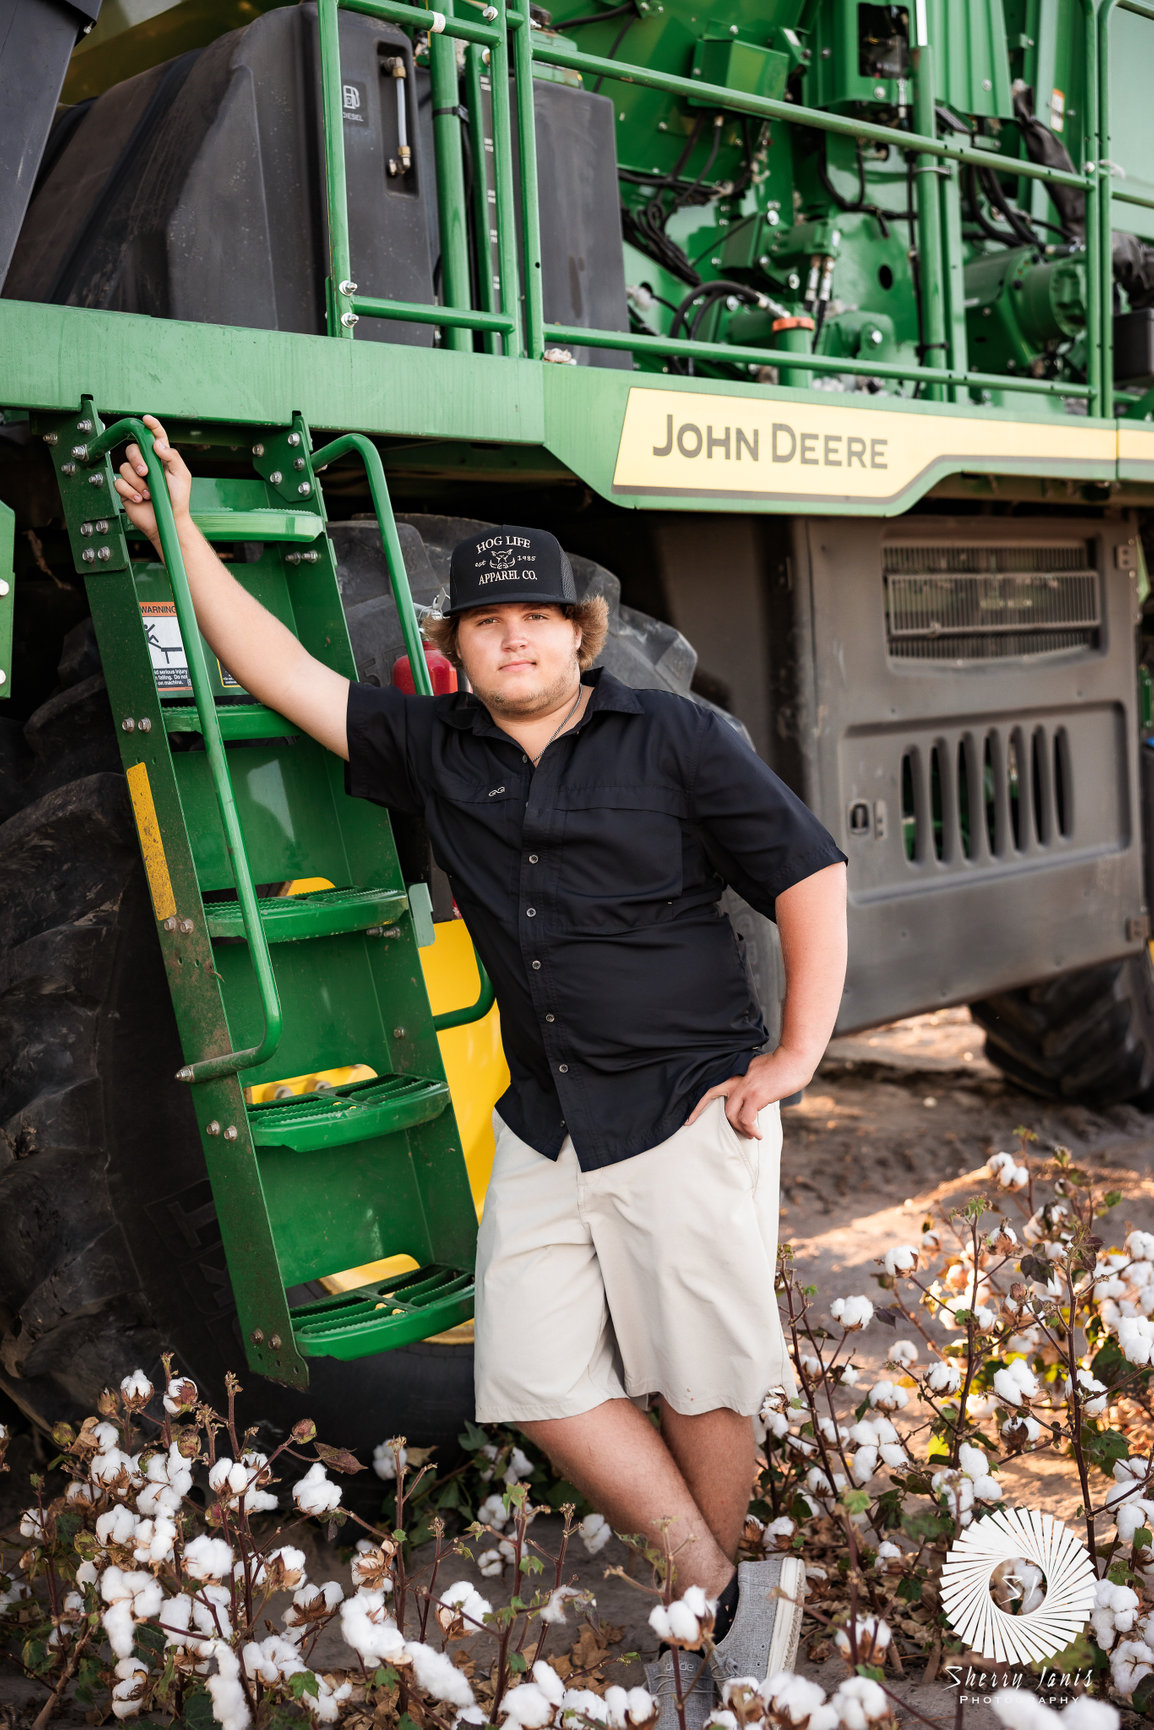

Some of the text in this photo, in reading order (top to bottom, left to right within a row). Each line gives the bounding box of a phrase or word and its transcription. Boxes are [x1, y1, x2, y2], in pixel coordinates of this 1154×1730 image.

[653, 414, 888, 469] JOHN DEERE
[476, 535, 531, 554] HOG LIFE
[478, 570, 520, 585] APPAREL
[141, 605, 176, 614] WARNING
[665, 1661, 694, 1672] dde
